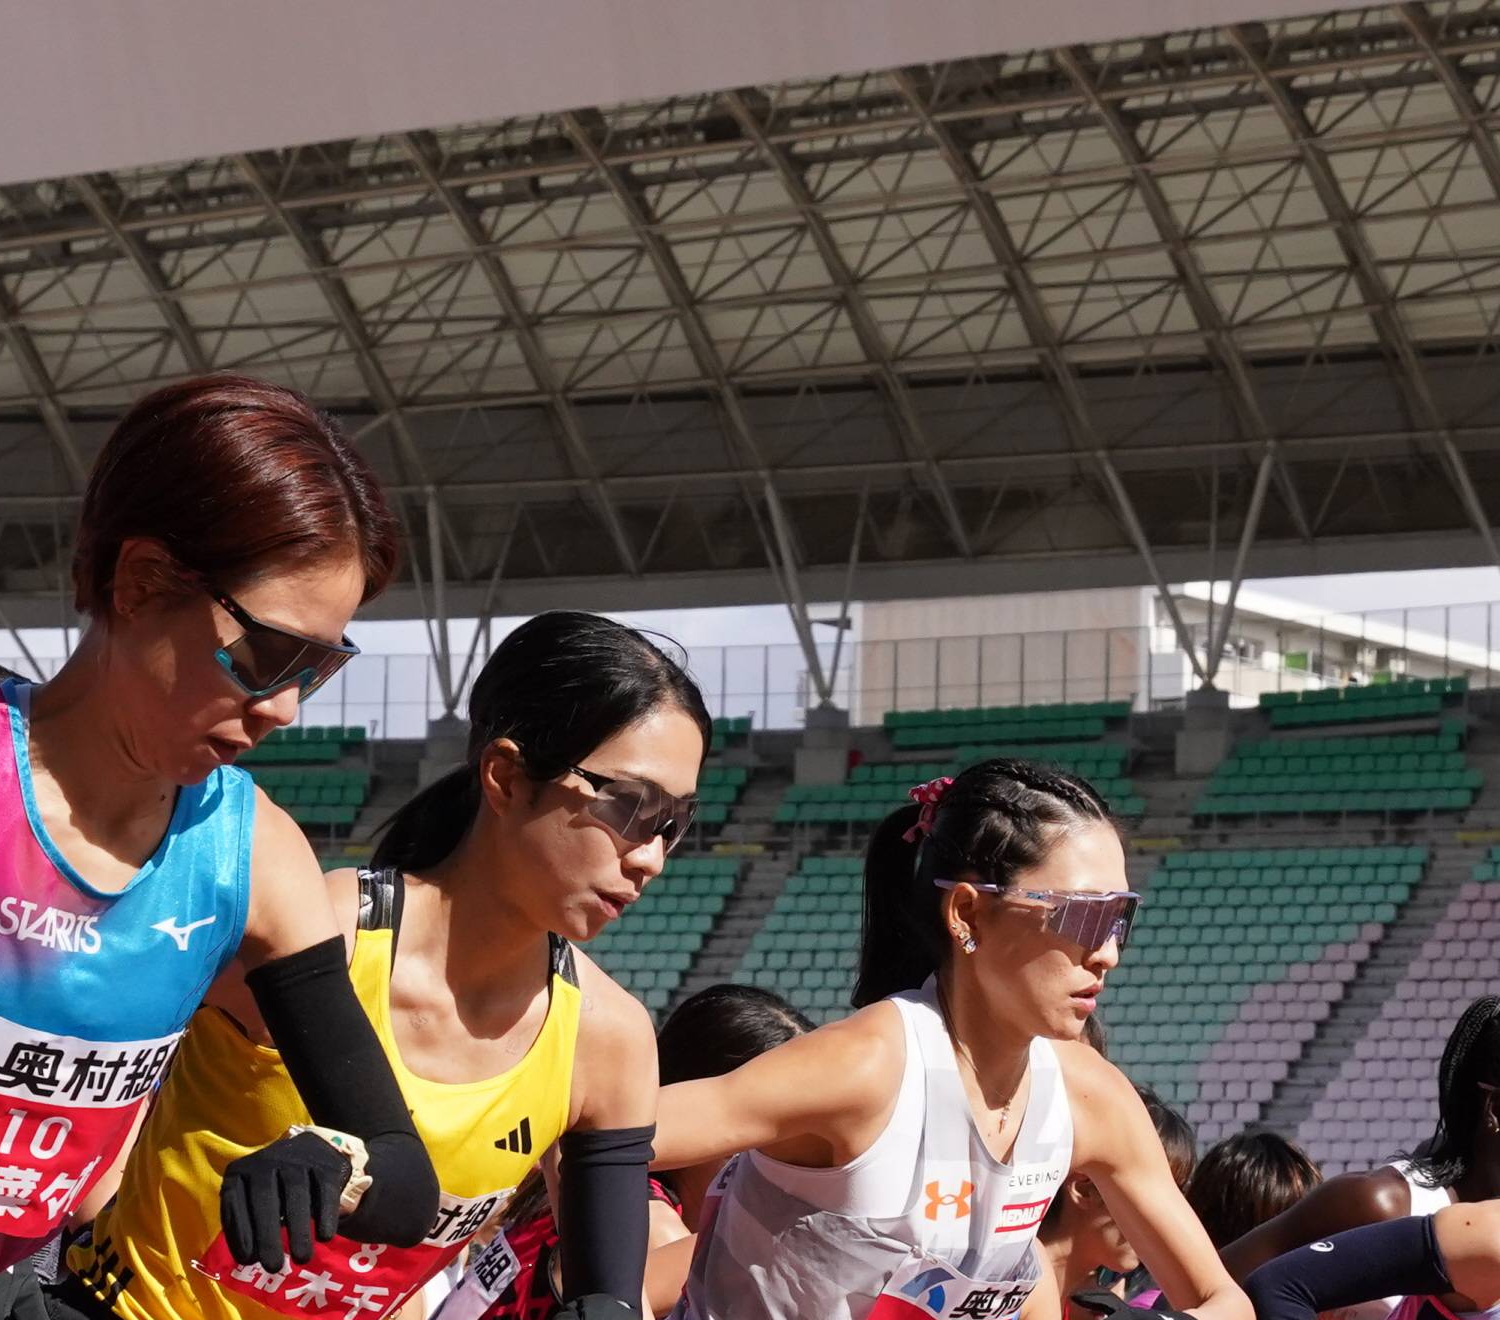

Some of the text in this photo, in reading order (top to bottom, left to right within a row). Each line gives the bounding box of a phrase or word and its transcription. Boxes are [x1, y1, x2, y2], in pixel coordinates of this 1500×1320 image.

[0, 1108, 73, 1160] 10
[349, 1243, 388, 1273] 8
[949, 1284, 1036, 1319] 奥村
